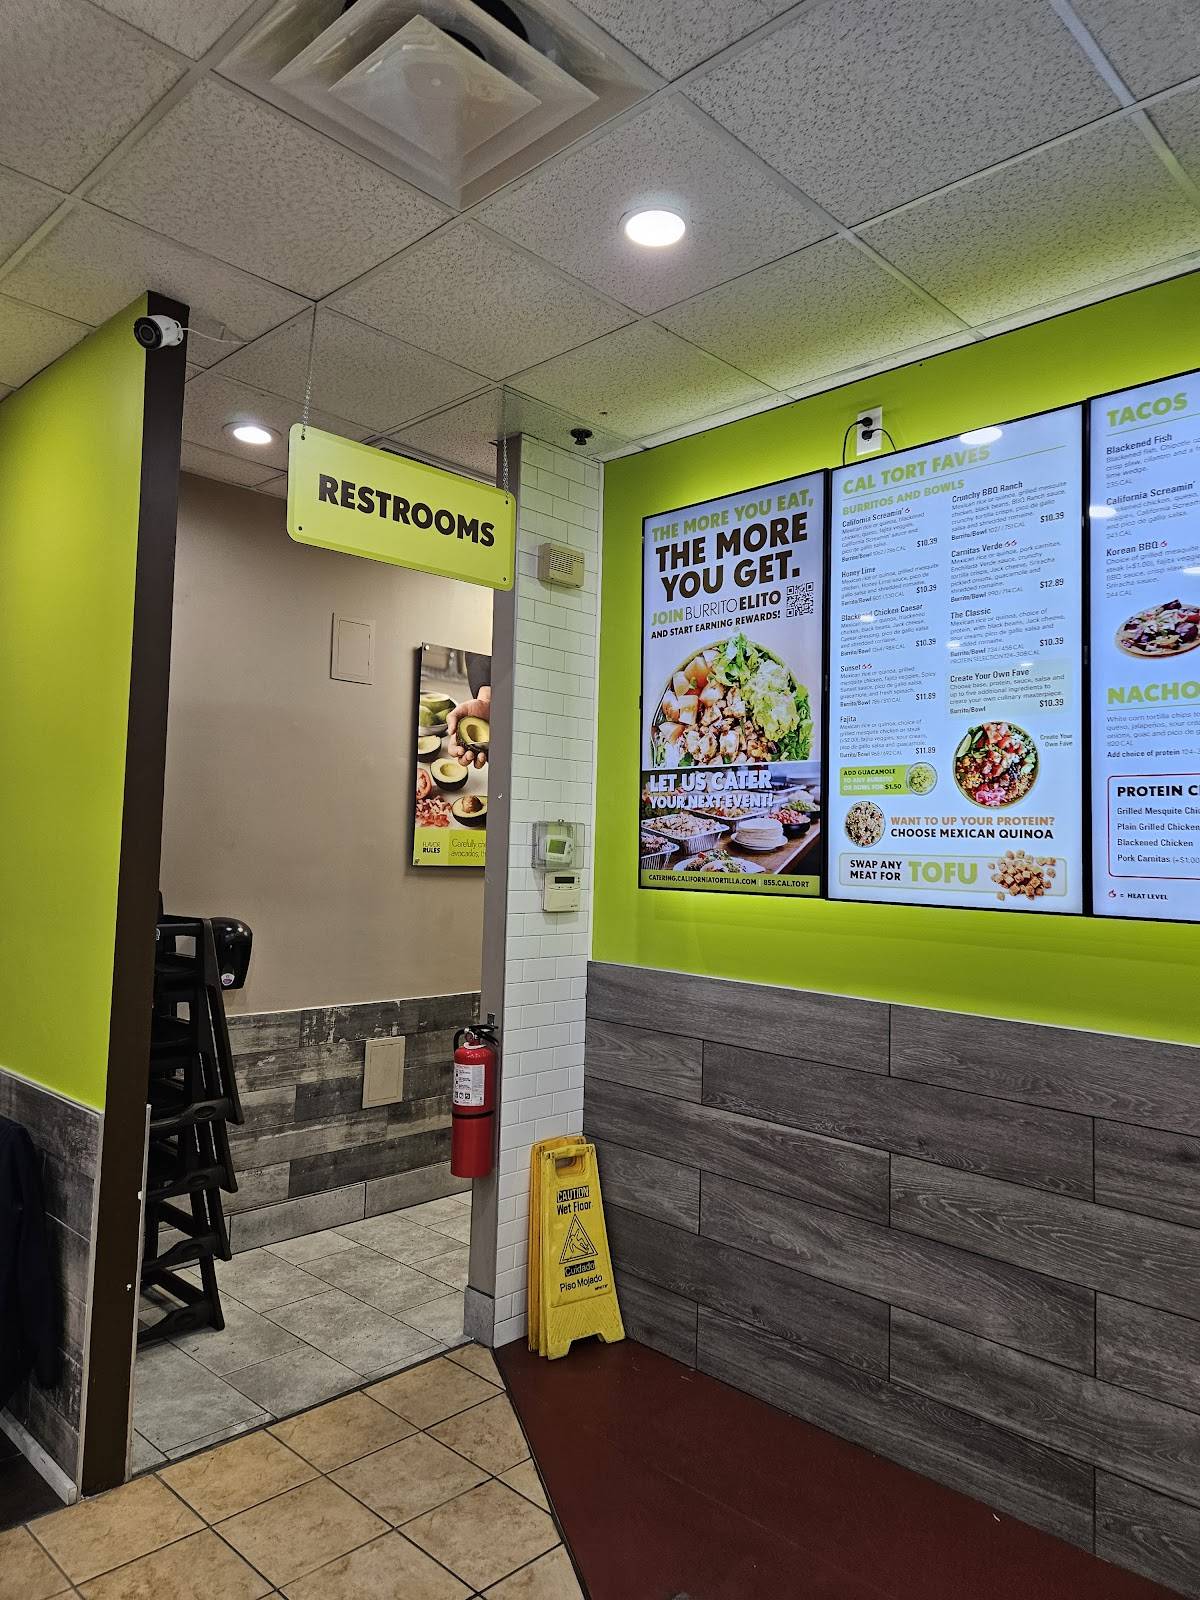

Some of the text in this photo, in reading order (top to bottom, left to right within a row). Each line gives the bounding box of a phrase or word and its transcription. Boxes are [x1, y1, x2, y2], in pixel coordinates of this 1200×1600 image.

[1106, 391, 1187, 428] TACOS
[1106, 432, 1172, 454] Blackened Fish
[843, 443, 989, 495] CAL TORT FAVES
[842, 478, 964, 515] BURRITOS AND BOWLS
[952, 480, 1022, 503] Crunchy BBQ Ranch
[1106, 490, 1147, 506] California
[318, 473, 495, 547] RESTROOMS
[652, 487, 813, 543] THE MORE YOU EAT,
[842, 507, 903, 527] California Screamin'
[1040, 511, 1064, 523] $10.39
[655, 536, 705, 573] THE
[716, 511, 807, 560] MORE
[917, 537, 937, 547] $10.39
[951, 541, 1002, 557] Carnitas Verde
[1106, 540, 1158, 556] Korean BBQ
[660, 564, 723, 603] YOU
[733, 547, 800, 589] GET.
[841, 565, 875, 578] Honey Lime
[916, 584, 936, 593] $10.39
[1040, 577, 1063, 588] $12.89
[874, 606, 898, 616] Chicken
[900, 602, 922, 612] Caesar
[951, 606, 991, 619] The Classic
[651, 607, 683, 626] JOIN
[651, 610, 780, 639] AND START EARNING REWARDS!
[915, 637, 936, 647] $10.39
[1040, 637, 1063, 646] $10.39
[840, 663, 860, 672] Sunset
[950, 667, 1029, 682] Create Your Own Fave
[915, 692, 935, 700] $11.89
[1040, 698, 1063, 707] $10.39
[840, 715, 856, 723] Fajita
[915, 746, 935, 754] $11.89
[1155, 748, 1179, 757] protein
[650, 769, 772, 792] LET US CATER
[1117, 785, 1182, 797] PROTEIN
[650, 793, 772, 809] YOUR NEXT EVENT!
[1144, 807, 1182, 815] Mesquite
[891, 816, 1054, 826] WANT TO UP YOUR PROTEIN?
[891, 828, 1053, 839] CHOOSE MEXICAN QUINOA
[1117, 838, 1158, 846] Blackened
[850, 859, 902, 870] SWAP ANY
[1137, 854, 1170, 862] Carnitas
[850, 870, 900, 881] MEAT FOR
[907, 860, 977, 885] TOFU
[648, 874, 809, 888] CATERING.CALIFORNIATORTILLA.COM 855.CAL.TORT
[556, 1186, 589, 1203] CAUTION
[556, 1201, 592, 1215] Wet Floor
[565, 1261, 595, 1276] Cuidado
[559, 1281, 577, 1293] Piso
[577, 1274, 603, 1288] Mojado
